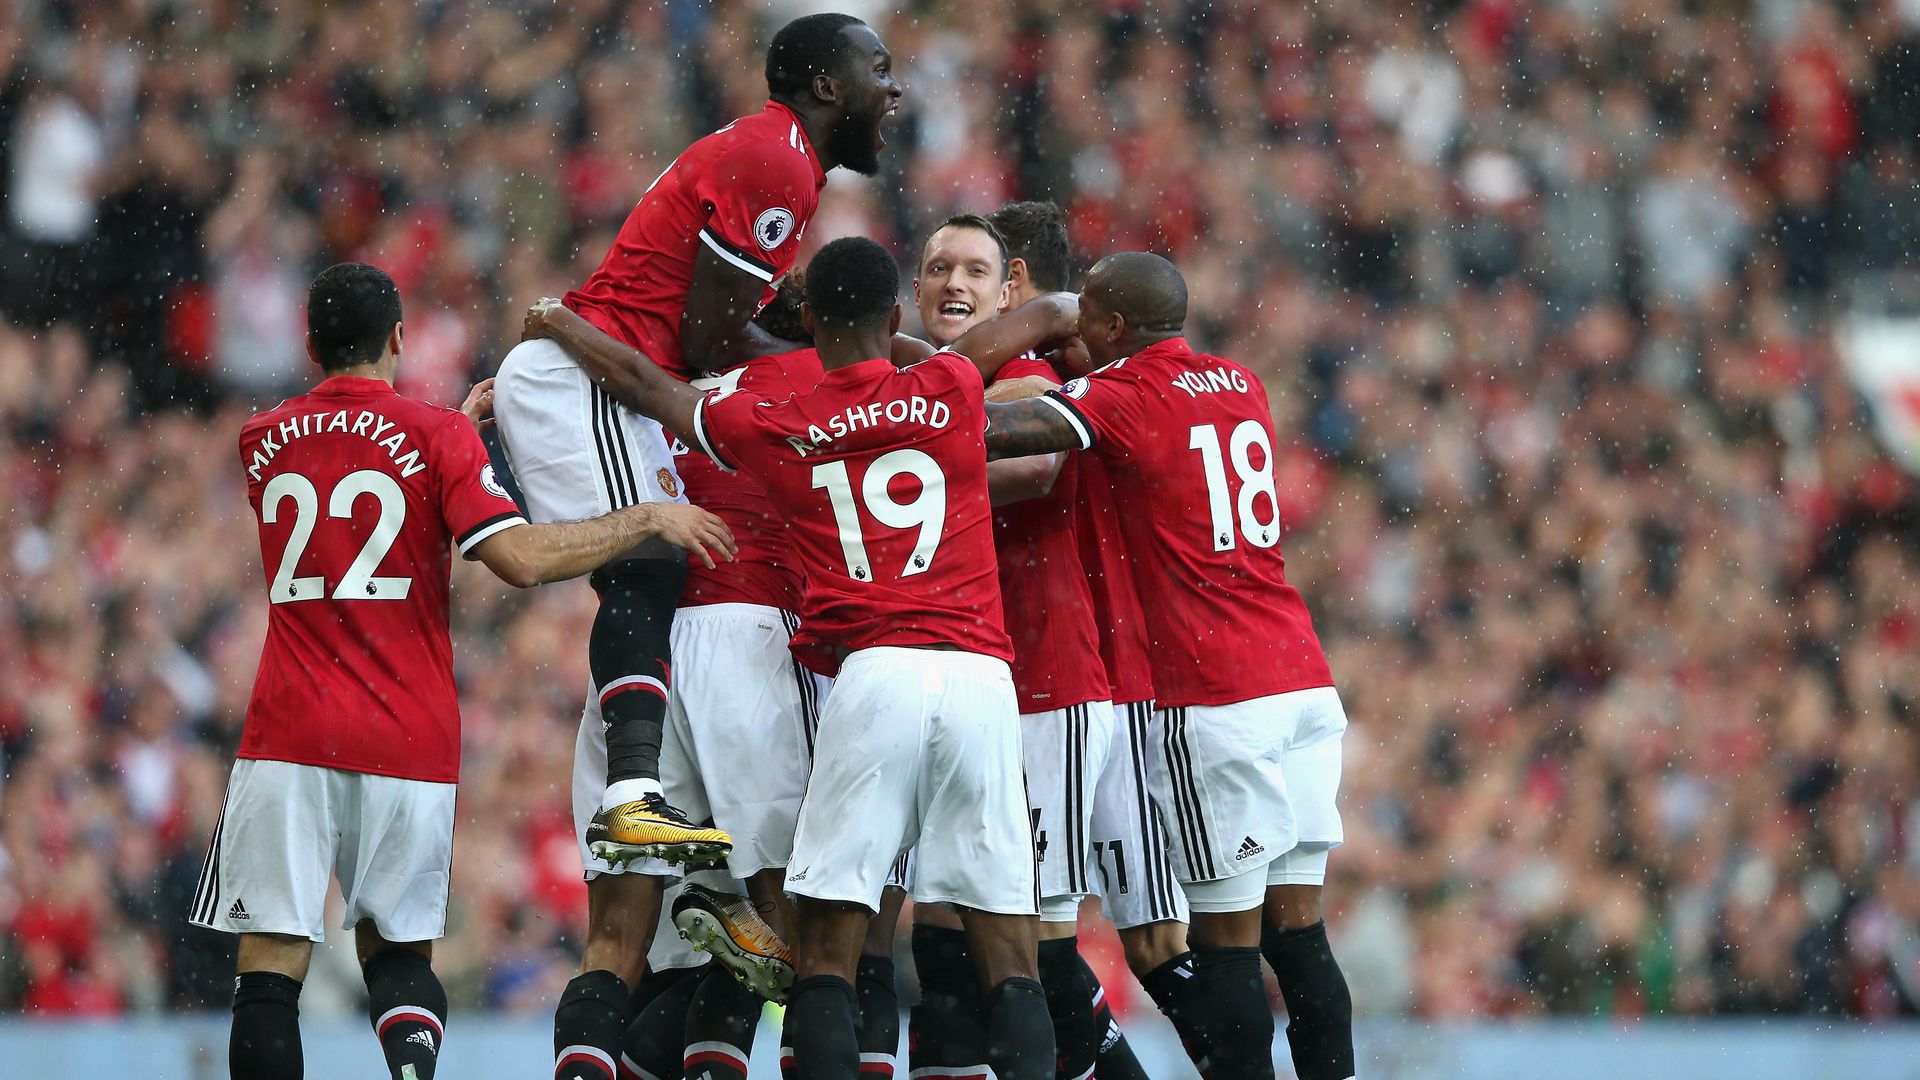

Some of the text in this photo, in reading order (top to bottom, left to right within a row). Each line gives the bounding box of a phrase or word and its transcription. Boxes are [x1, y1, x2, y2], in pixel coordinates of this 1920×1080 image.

[1171, 367, 1248, 399] YOUNG
[248, 410, 426, 482] MKHITARYAN
[785, 395, 950, 458] RASHFORD
[811, 448, 947, 583] 19
[1188, 419, 1281, 552] 18
[262, 469, 413, 604] 22
[1235, 845, 1265, 861] adidas
